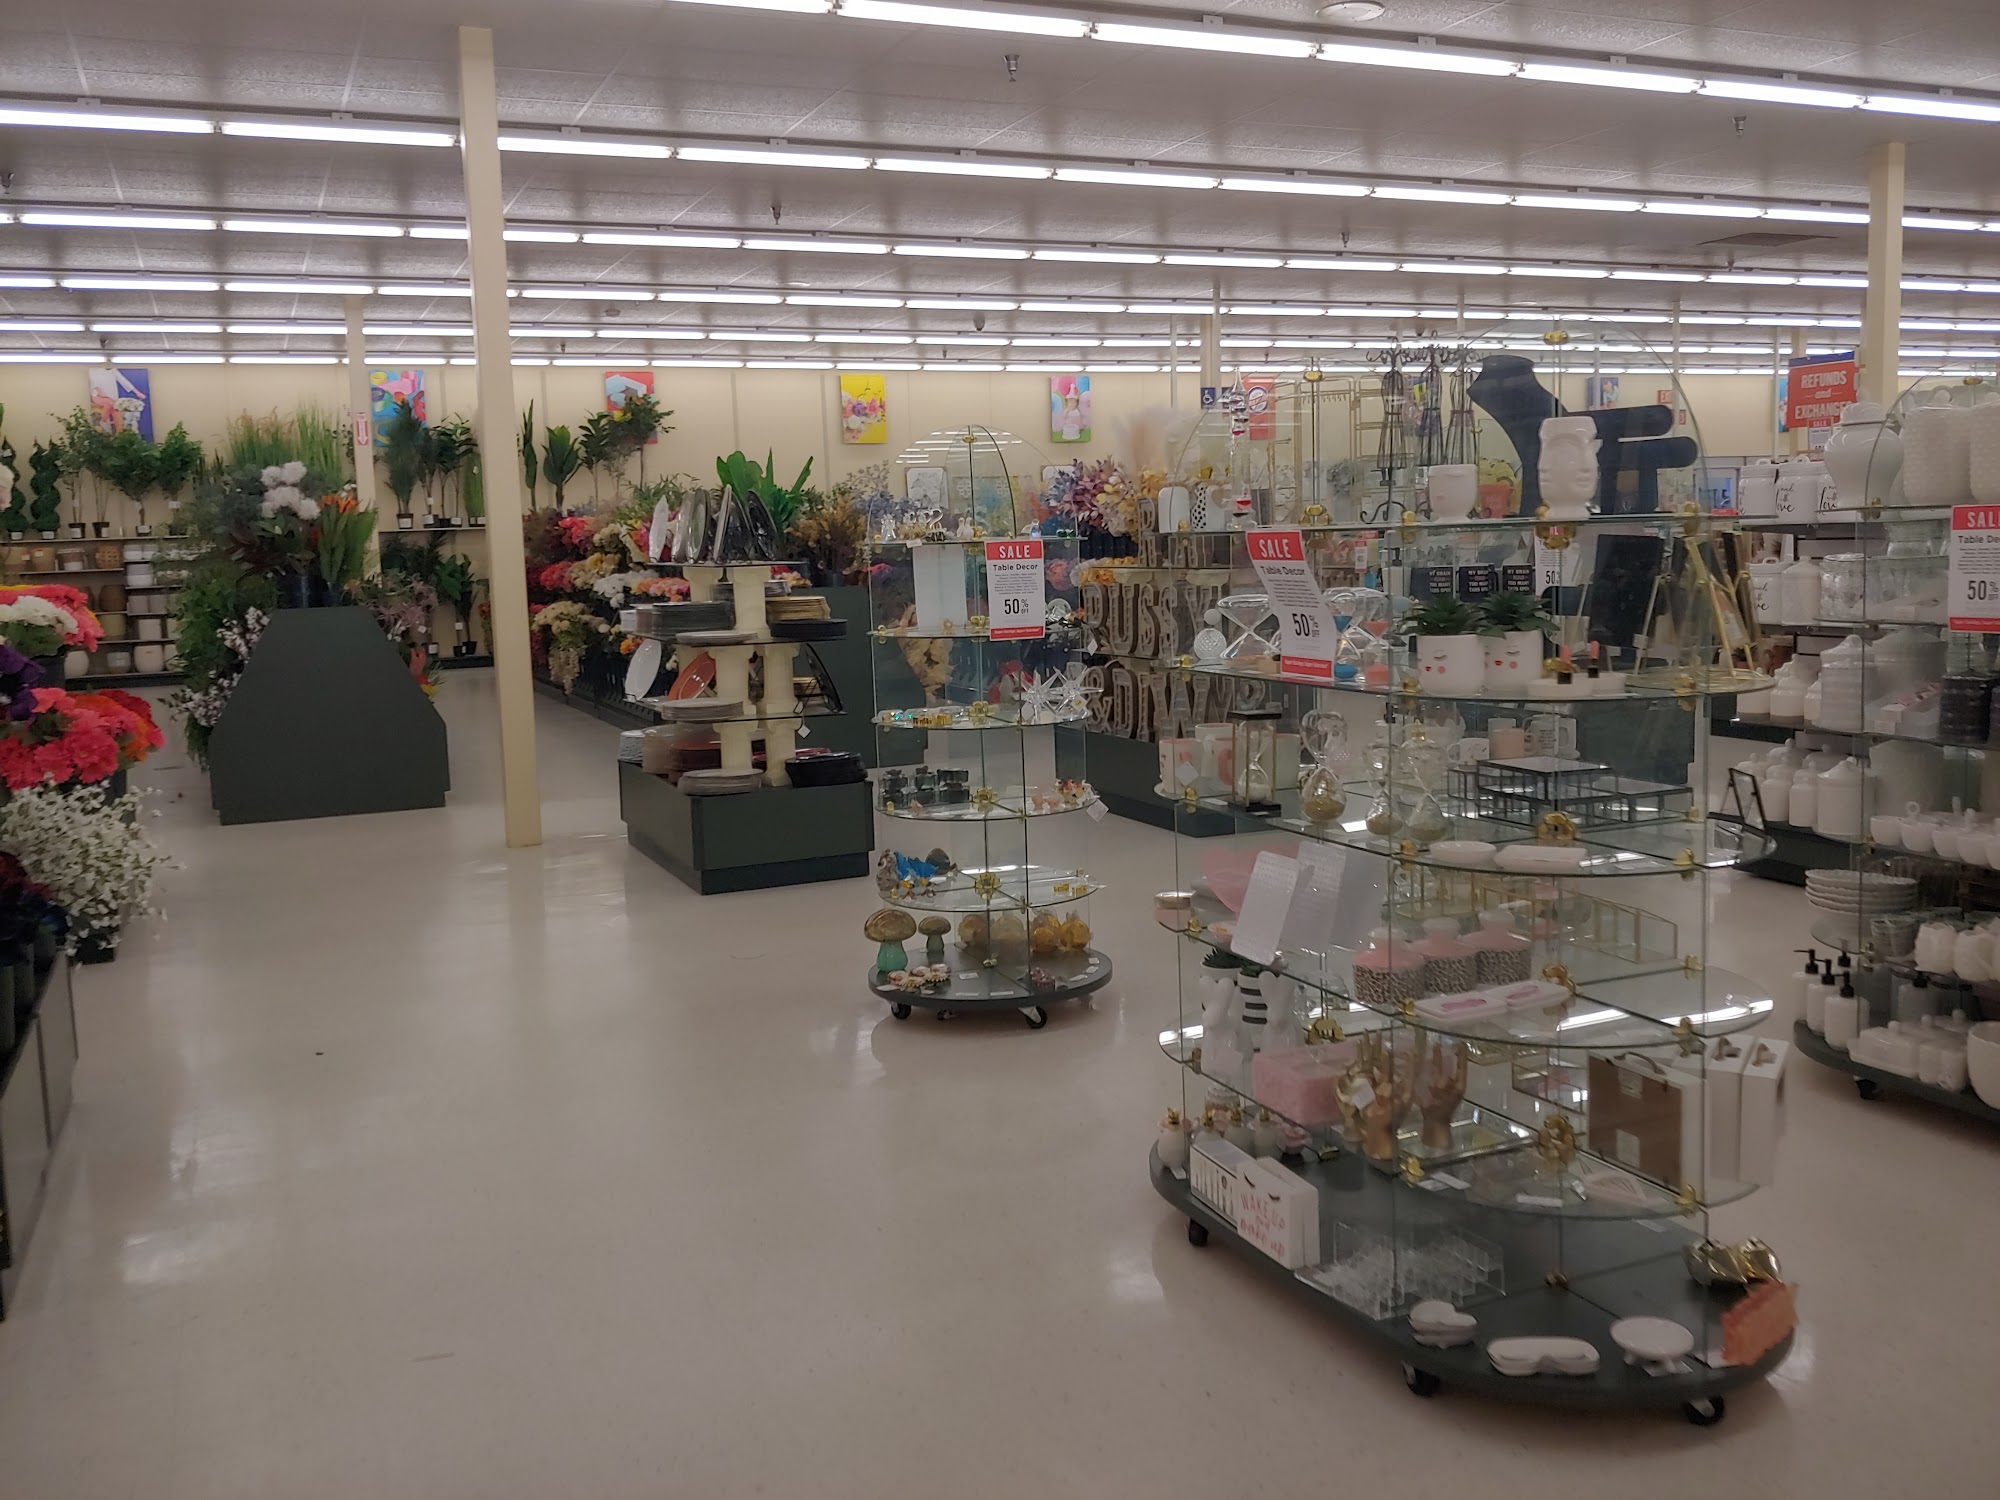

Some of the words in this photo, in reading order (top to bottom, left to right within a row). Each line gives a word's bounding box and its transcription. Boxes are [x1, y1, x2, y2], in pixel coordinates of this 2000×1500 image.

[1801, 370, 1847, 388] REFUNDS
[1815, 388, 1832, 399] and
[1795, 401, 1853, 419] EXCHANG
[1958, 535, 1984, 544] Table
[999, 544, 1031, 559] SALE
[1258, 538, 1293, 559] SALE
[993, 563, 1014, 571] Table
[1016, 563, 1038, 571] Decor
[1260, 565, 1282, 575] Table
[1282, 566, 1305, 576] Decor
